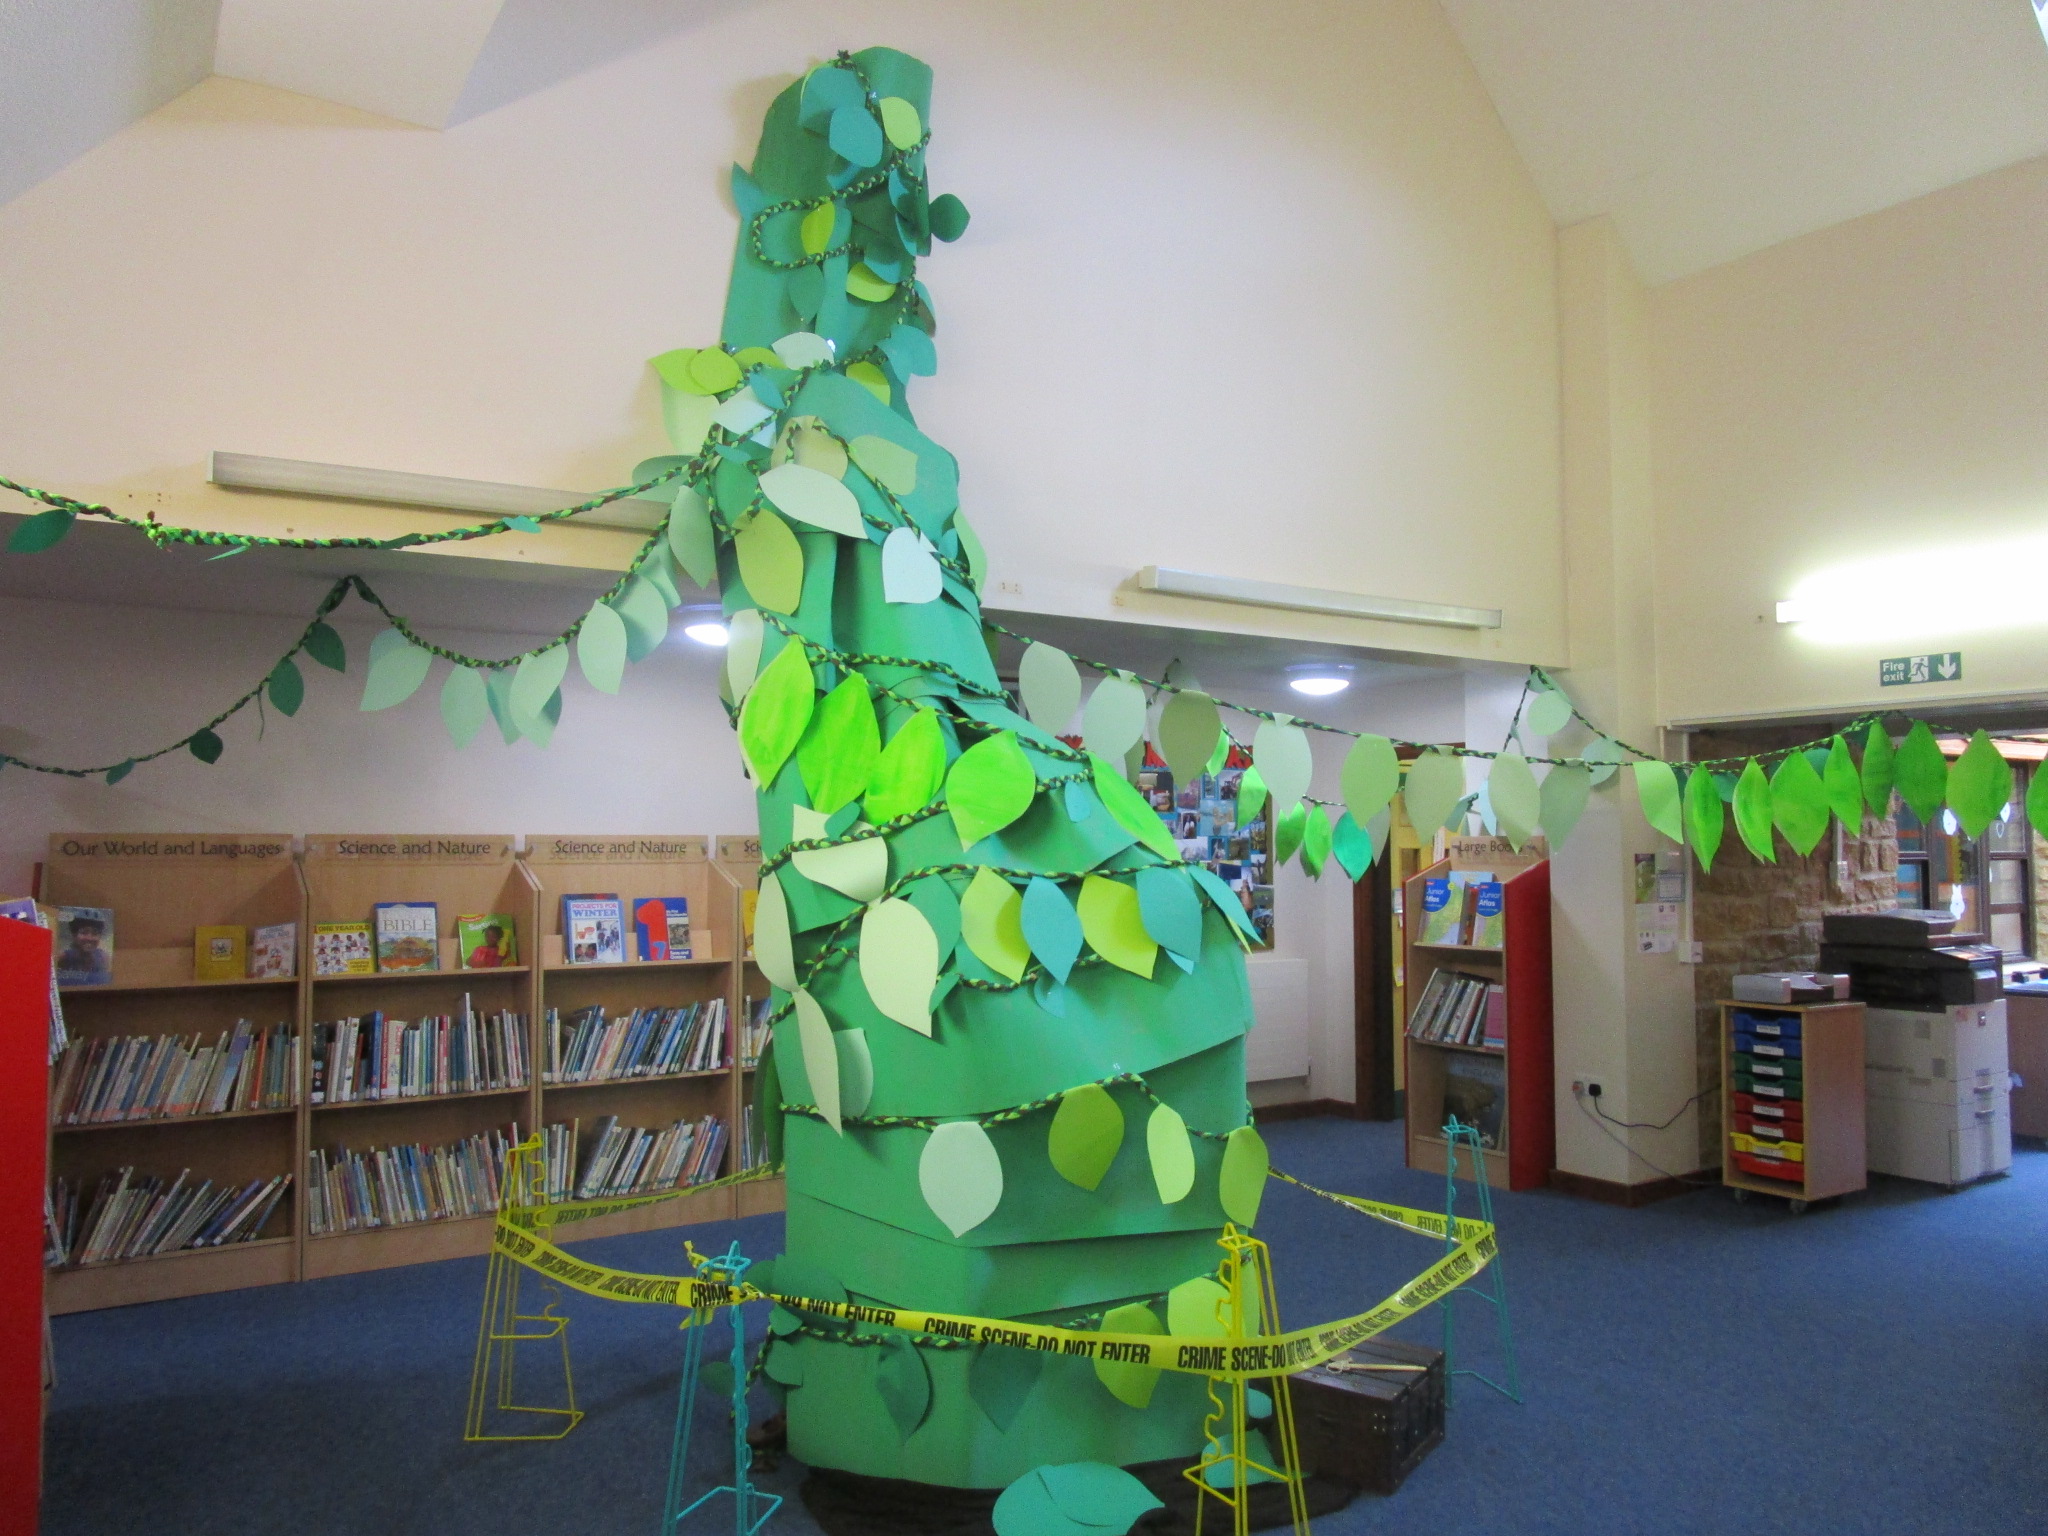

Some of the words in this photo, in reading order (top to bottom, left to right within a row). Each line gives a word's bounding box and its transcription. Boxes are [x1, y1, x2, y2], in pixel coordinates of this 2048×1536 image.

[1883, 662, 1905, 672] Fire
[1883, 672, 1905, 681] exit
[62, 840, 98, 856] Our
[104, 840, 158, 856] World
[163, 840, 195, 855] and
[201, 840, 281, 859] Languages
[338, 840, 396, 855] Science
[402, 840, 433, 855] and
[437, 840, 491, 855] Nature
[555, 839, 604, 854] Science
[609, 840, 635, 854] and
[640, 840, 687, 854] Nature
[1459, 840, 1487, 855] Large
[1479, 899, 1496, 907] Atlas
[573, 909, 618, 917] WINTER
[384, 920, 432, 932] BIBLE
[690, 1283, 733, 1308] CRIME
[808, 1298, 842, 1317] NOT
[844, 1304, 897, 1327] ENTER
[923, 1317, 977, 1341] CRIME
[1063, 1338, 1098, 1359] NOT
[1100, 1341, 1151, 1365] ENTER
[1178, 1345, 1226, 1371] CRIME
[1231, 1344, 1286, 1371] SCENE-DO
